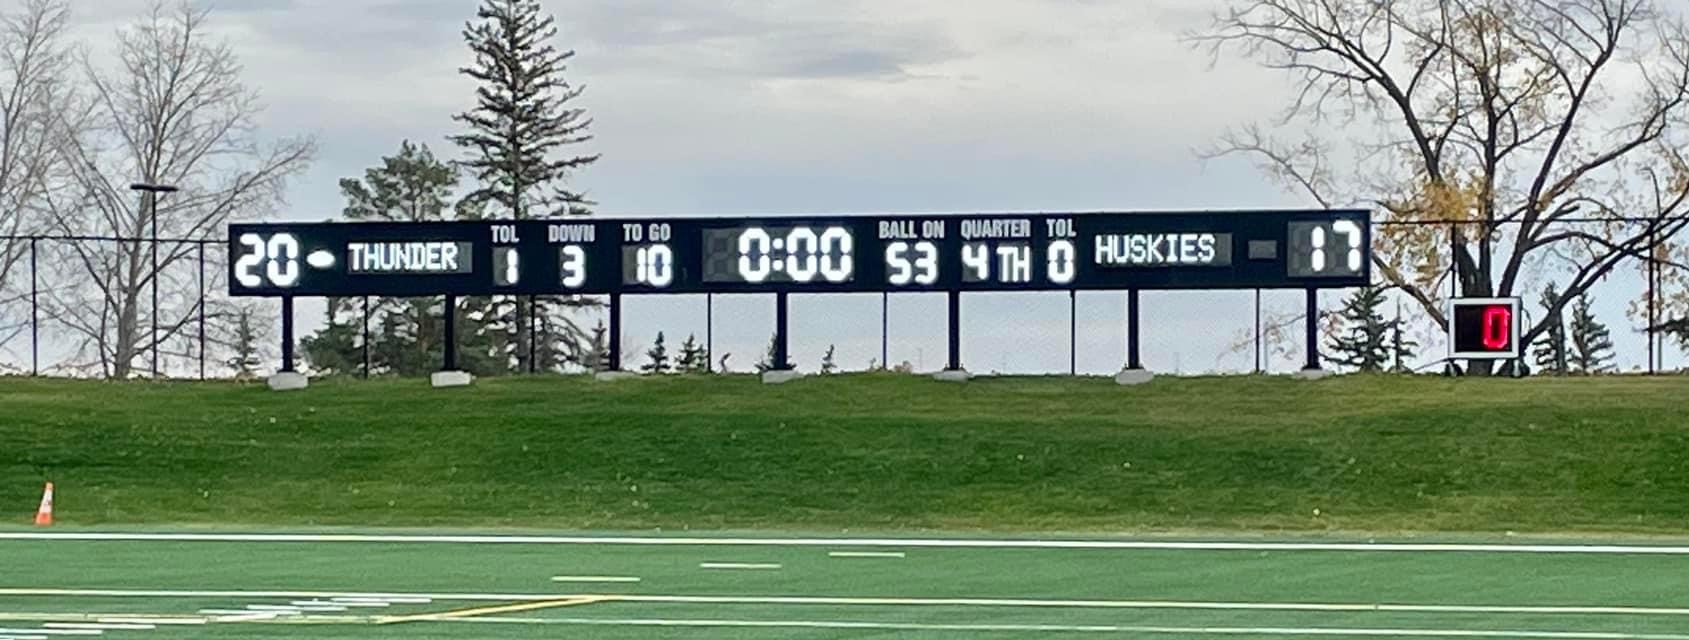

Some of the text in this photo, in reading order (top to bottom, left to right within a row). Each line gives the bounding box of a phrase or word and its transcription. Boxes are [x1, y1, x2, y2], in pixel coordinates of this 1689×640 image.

[490, 224, 520, 245] TOL
[548, 224, 596, 244] DOWN
[622, 222, 671, 243] TO GO
[879, 219, 945, 239] BALL ON
[960, 219, 1031, 239] QUARTER
[1046, 219, 1076, 238] TOL
[1311, 221, 1361, 272] 17
[234, 233, 299, 287] 20
[348, 241, 458, 271] THUNDER
[506, 249, 519, 285] 1
[562, 245, 587, 287] 3
[636, 244, 673, 286] 10
[738, 227, 853, 283] 0:00
[885, 241, 938, 285] 53
[961, 244, 1032, 283] 4 TH
[1047, 239, 1075, 284] 0
[1095, 234, 1216, 264] HUSKIES
[1483, 305, 1511, 349] 0
